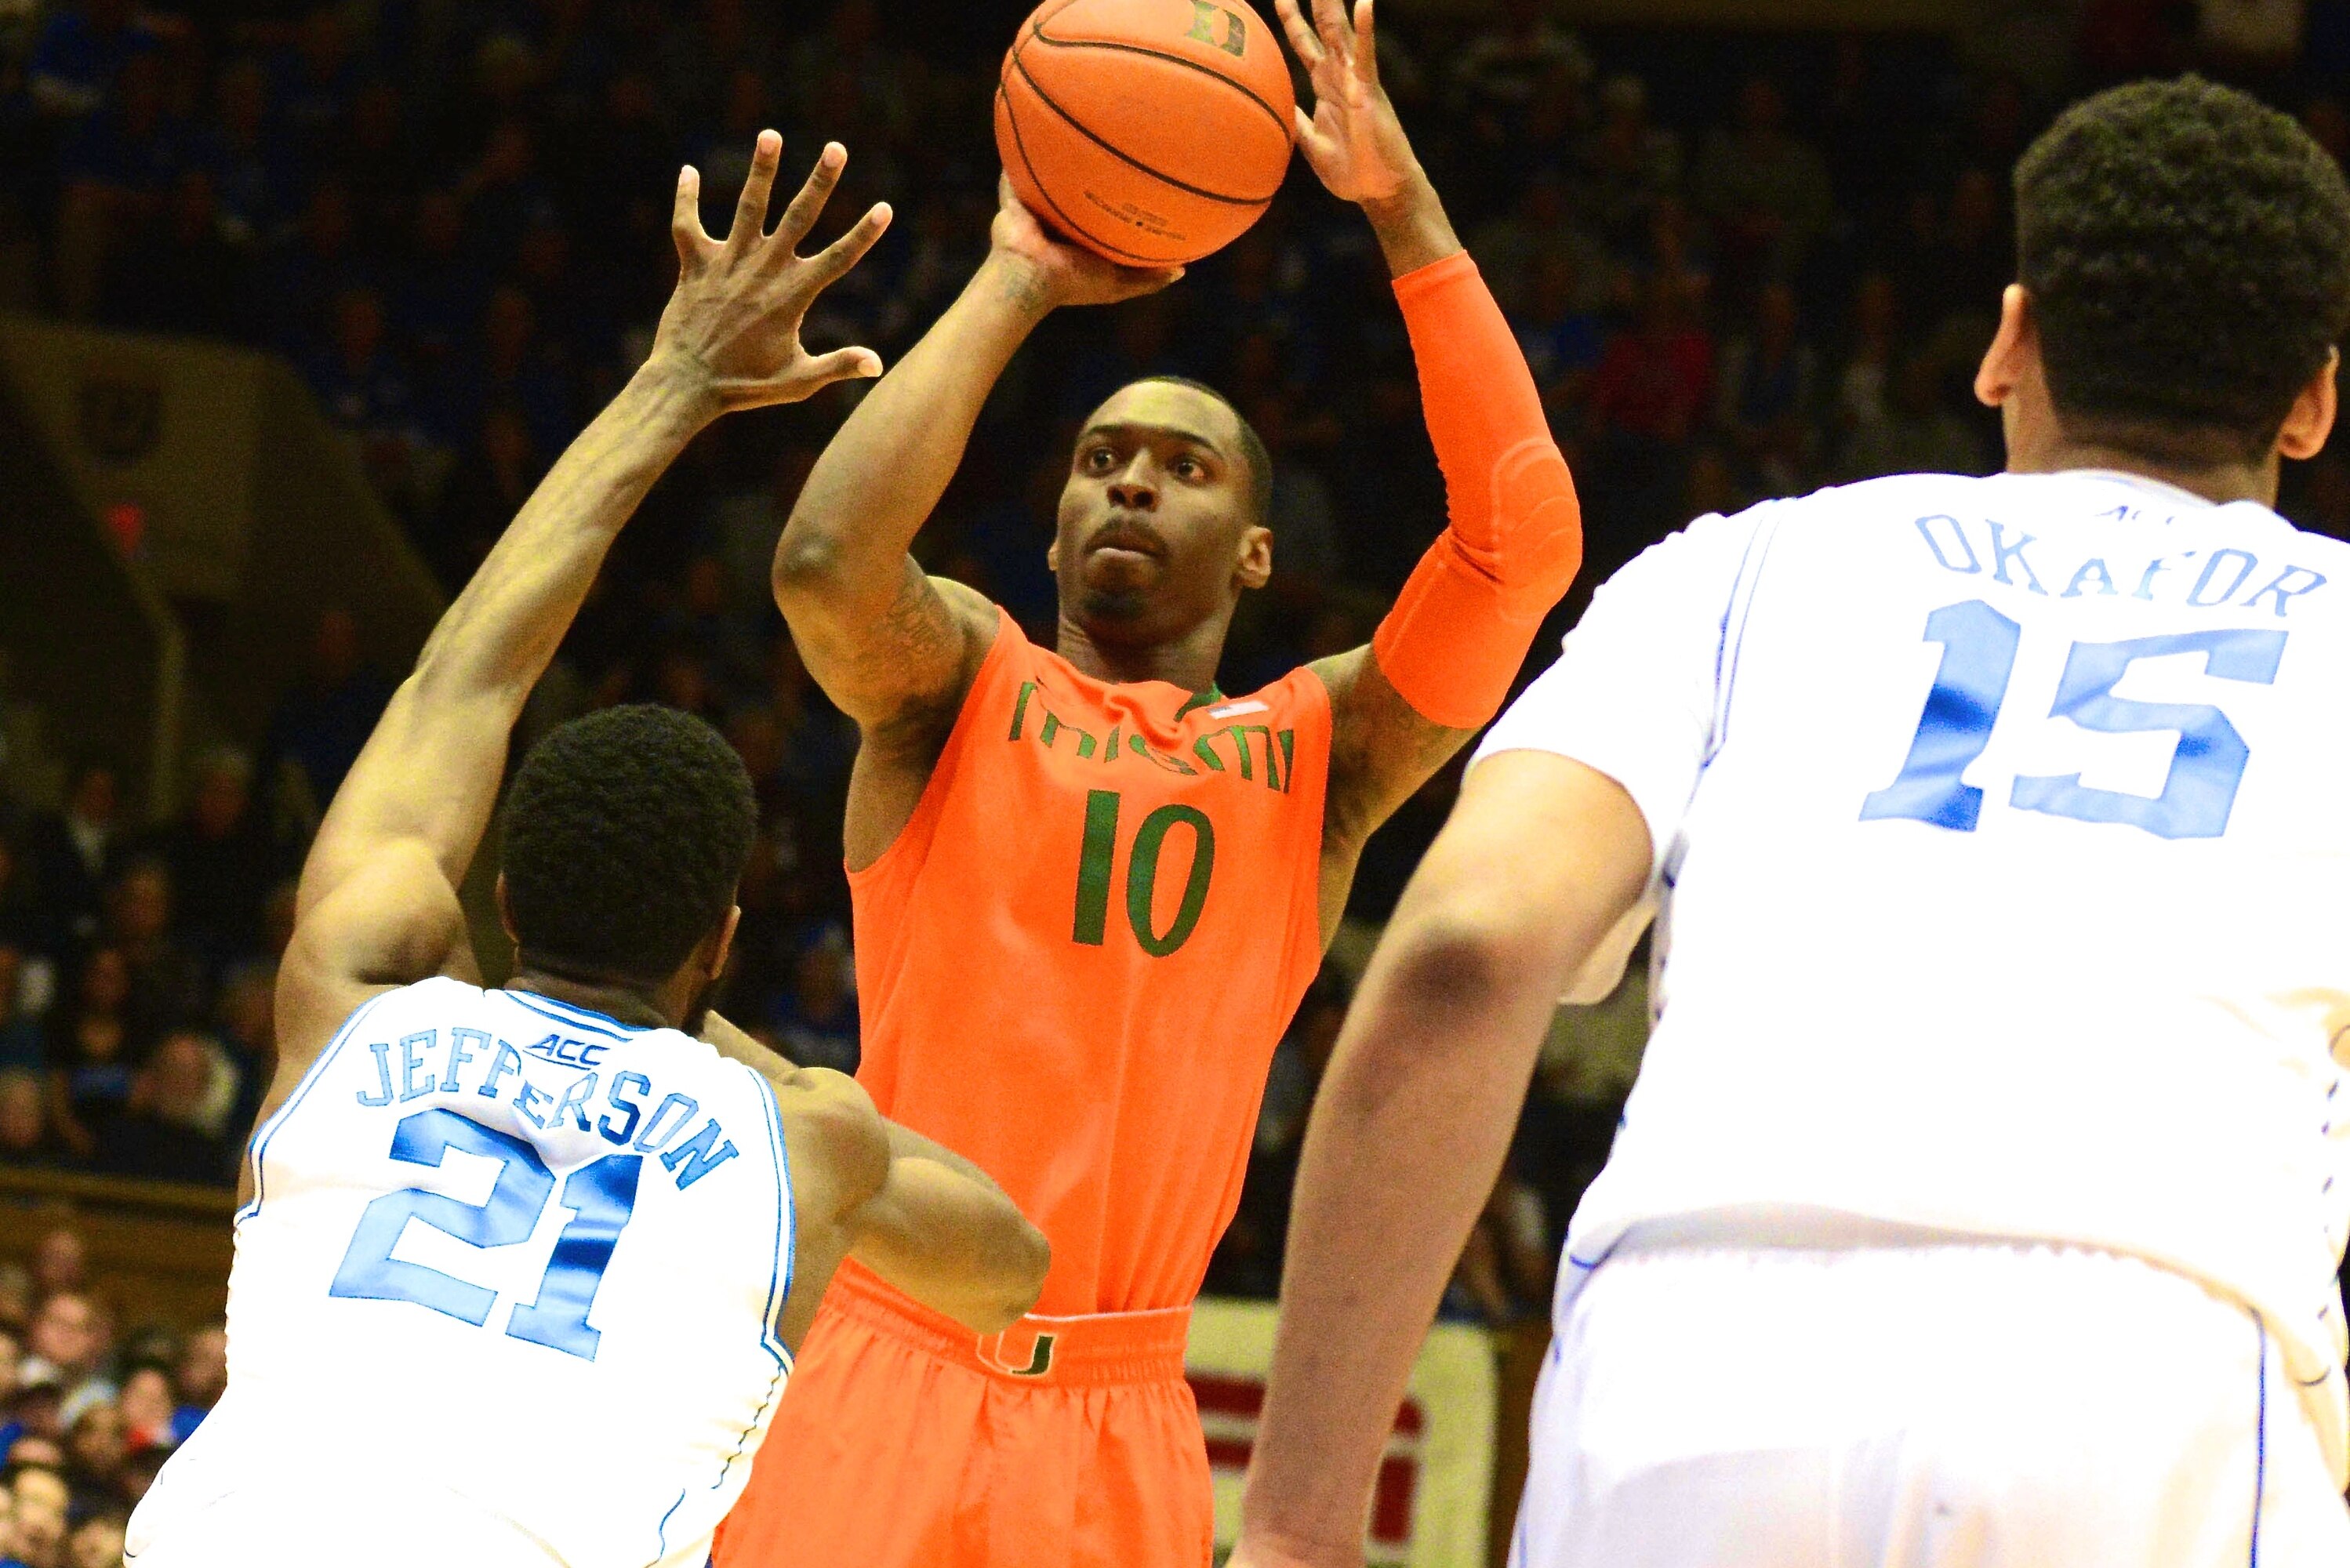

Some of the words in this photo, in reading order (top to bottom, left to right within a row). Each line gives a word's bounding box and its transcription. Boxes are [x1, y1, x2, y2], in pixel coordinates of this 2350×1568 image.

[1914, 514, 2326, 617] OKAFOR
[1858, 599, 2289, 840] 15
[1073, 789, 1215, 957] 10
[357, 1027, 739, 1190] JEFFERSON
[525, 1033, 610, 1069] ACC
[329, 1107, 644, 1363] 21
